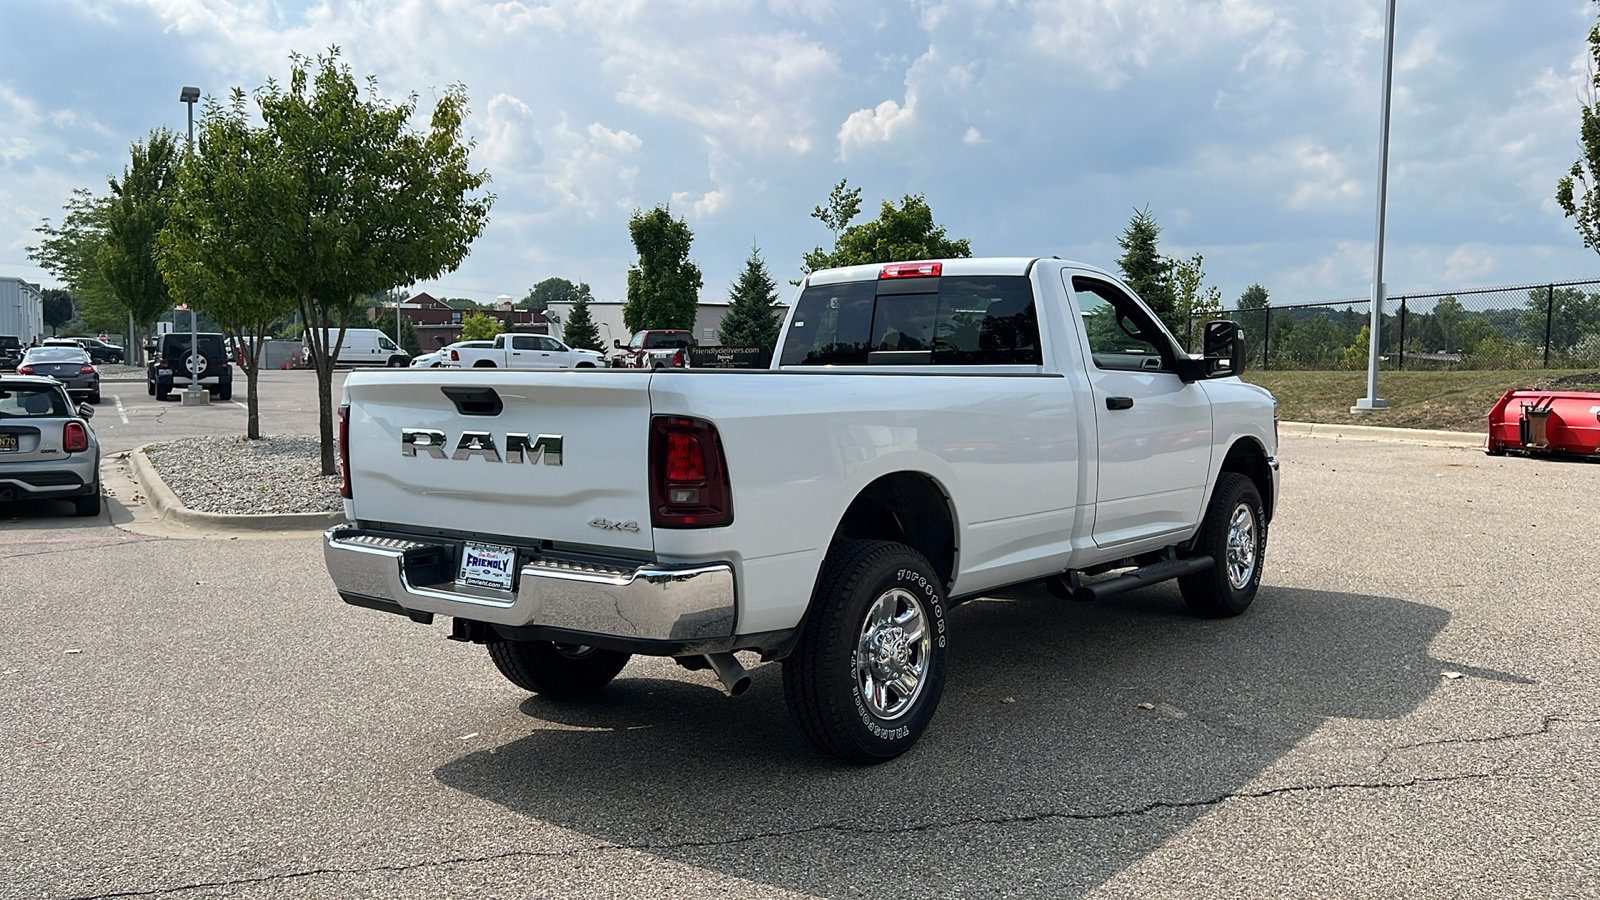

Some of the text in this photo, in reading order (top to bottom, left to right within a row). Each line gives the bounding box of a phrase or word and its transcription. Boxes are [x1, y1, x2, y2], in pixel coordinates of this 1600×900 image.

[692, 347, 760, 356] Friendlydelivers.com
[402, 428, 564, 467] RAM
[466, 552, 510, 573] FRIENDLY
[852, 685, 910, 740] TRANSFORCE
